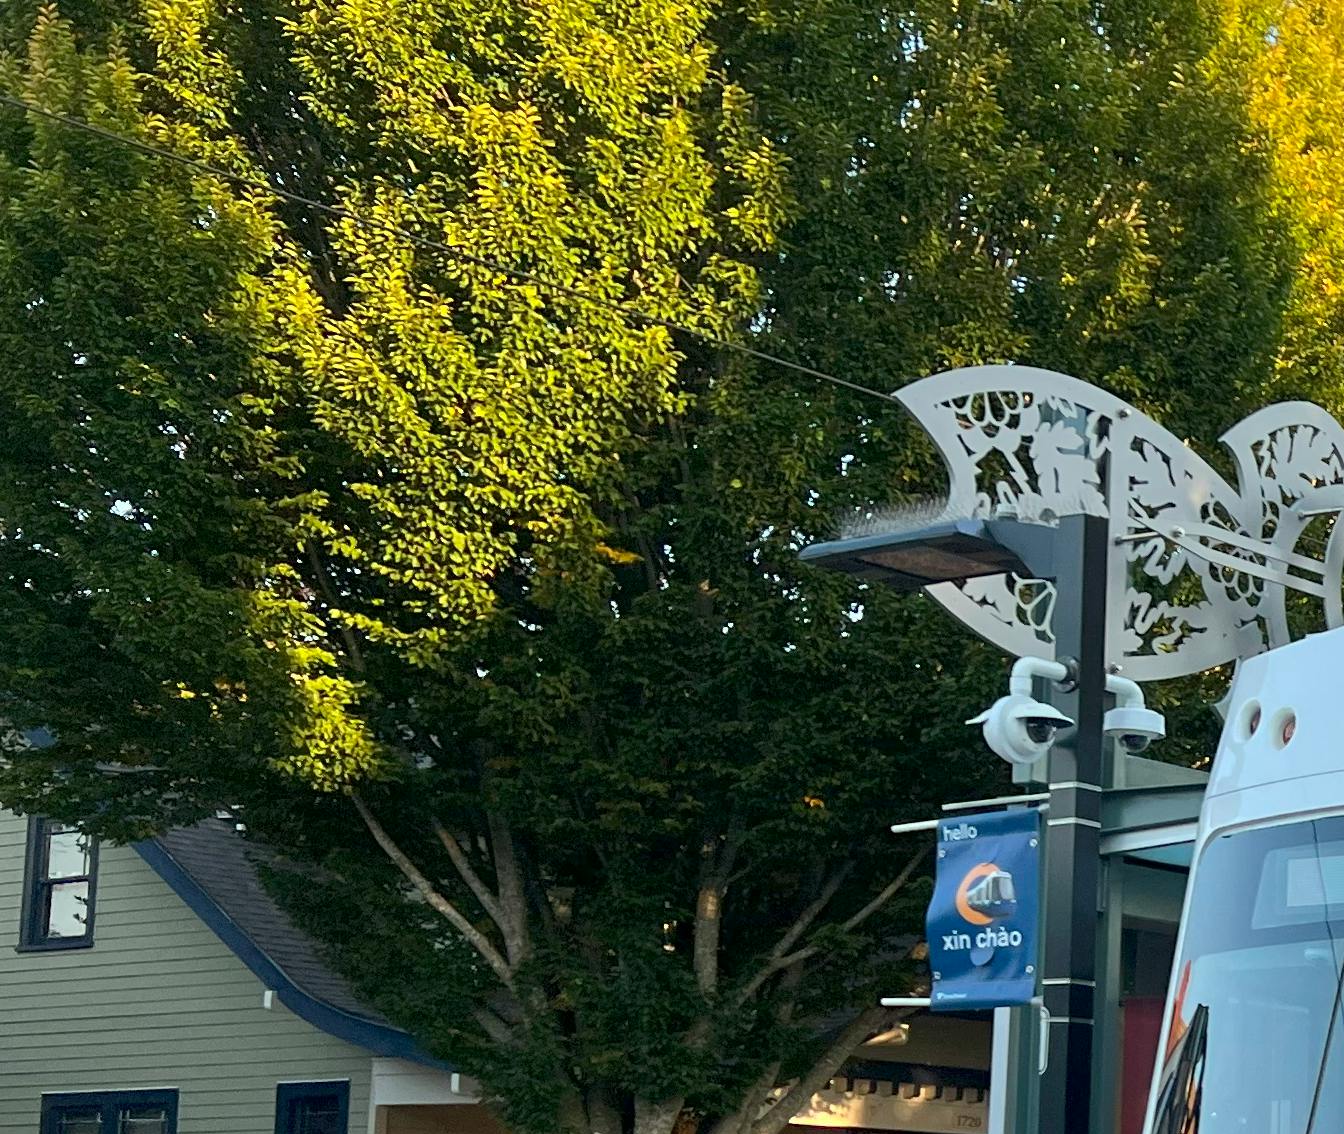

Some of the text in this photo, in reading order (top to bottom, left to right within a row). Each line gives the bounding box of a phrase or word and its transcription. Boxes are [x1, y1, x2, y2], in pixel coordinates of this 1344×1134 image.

[943, 823, 978, 842] hello
[942, 926, 1023, 951] xin chào
